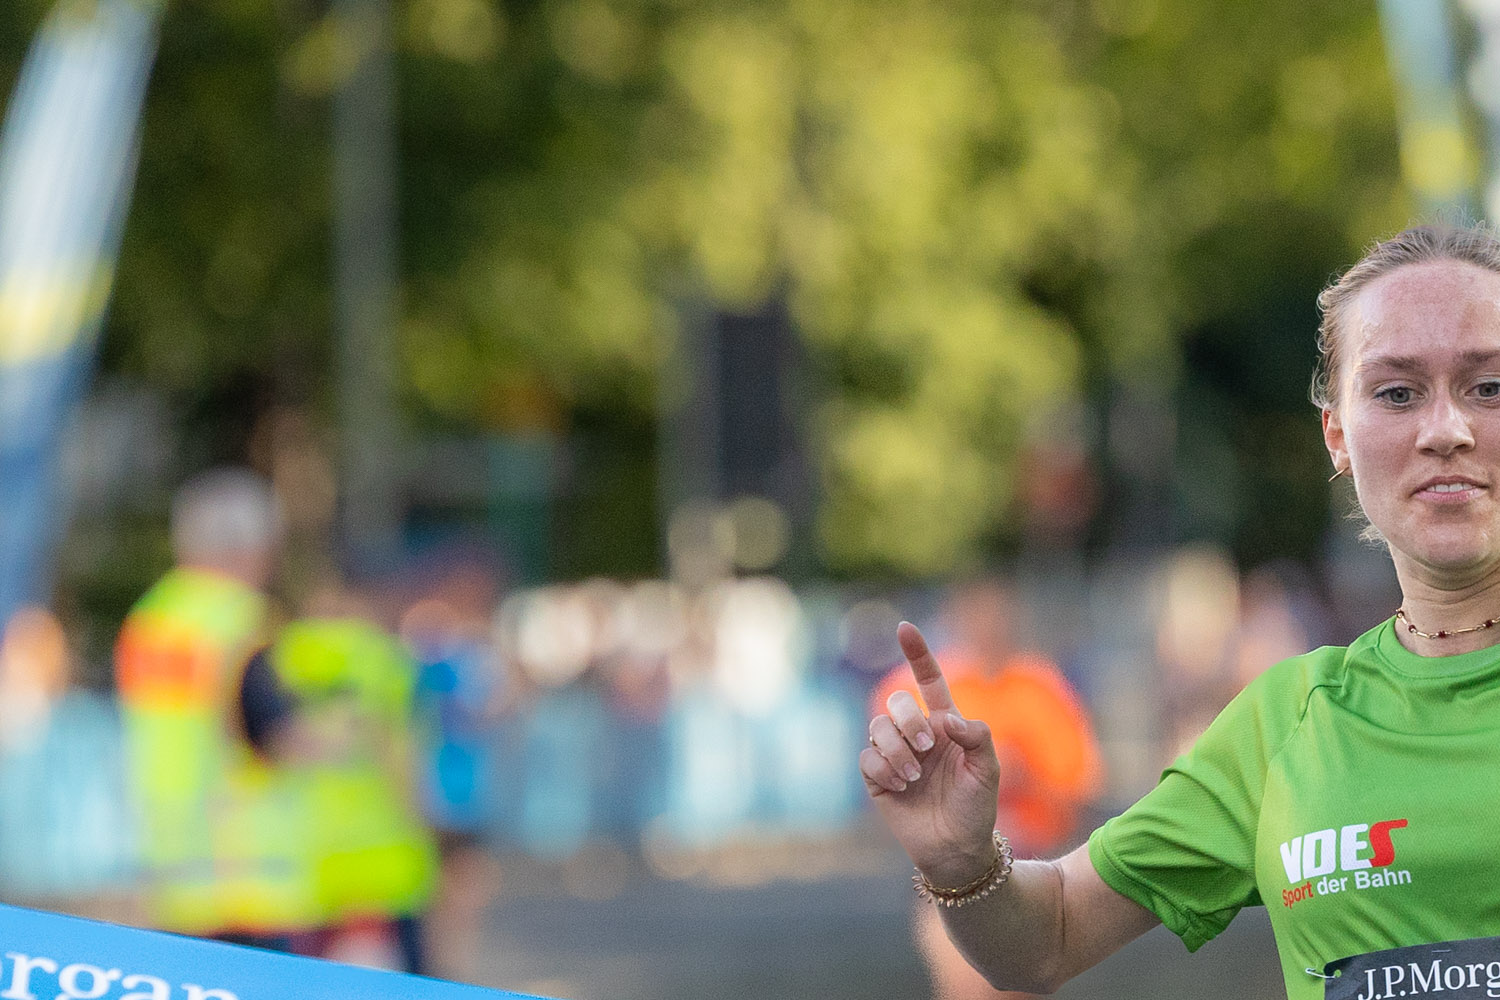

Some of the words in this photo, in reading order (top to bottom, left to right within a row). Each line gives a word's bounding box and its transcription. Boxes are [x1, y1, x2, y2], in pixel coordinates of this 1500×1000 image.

[1282, 881, 1314, 909] Sport
[1316, 876, 1349, 896] der
[1354, 867, 1412, 891] Bahn
